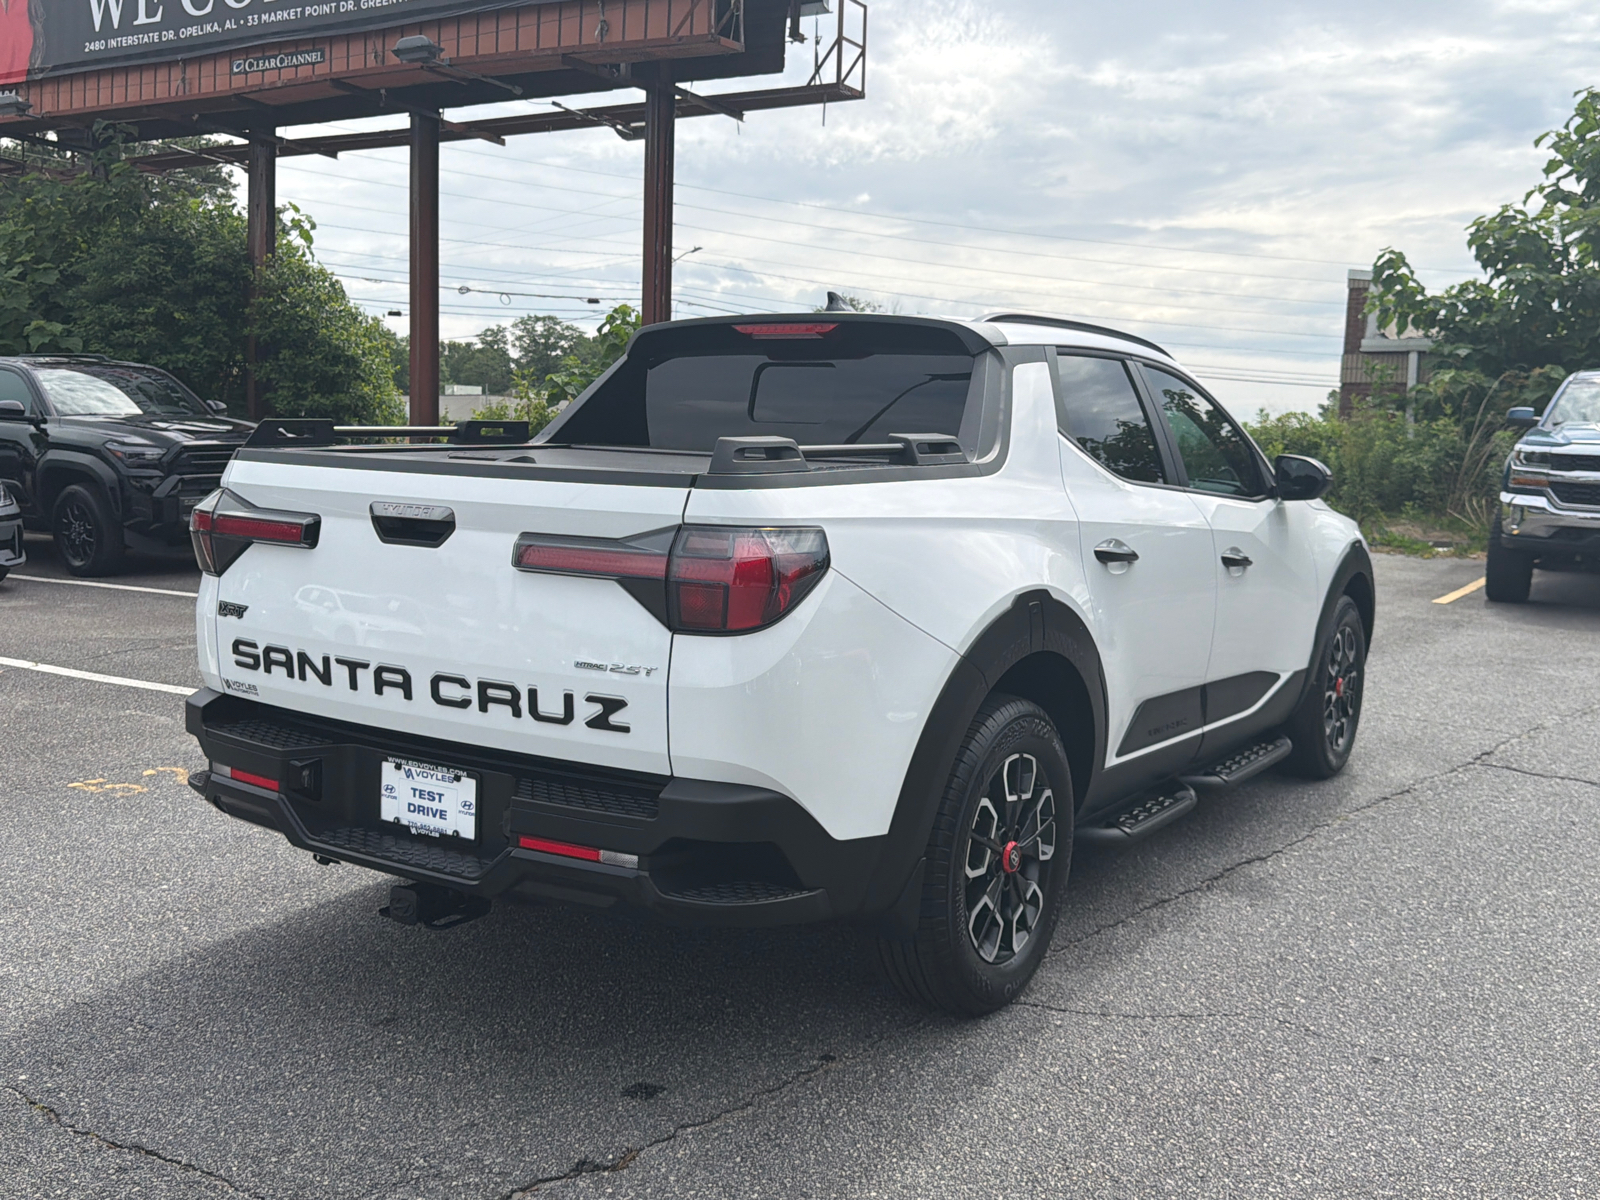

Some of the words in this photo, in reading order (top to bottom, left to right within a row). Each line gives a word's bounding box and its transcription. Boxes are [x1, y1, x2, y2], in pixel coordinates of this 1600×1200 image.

[84, 40, 106, 52] 2480
[107, 33, 159, 49] INTERSTATE
[161, 30, 177, 42] DR.
[179, 23, 222, 38] OPELIKA,
[224, 18, 237, 30] AL
[247, 15, 259, 26] 33
[261, 8, 301, 24] MARKET
[305, 3, 336, 18] POINT
[339, 1, 357, 12] DR.
[383, 504, 435, 517] HYUNDAI
[220, 602, 246, 616] XRT
[576, 661, 605, 671] HTRAC
[231, 680, 258, 691] VOYLES
[232, 638, 413, 700] SANTA
[429, 671, 632, 734] CRUZ
[387, 756, 467, 777] WWW.EDVOYLES.COM
[415, 769, 454, 784] VOYLES
[410, 787, 445, 803] TEST
[407, 802, 448, 821] DRIVE
[417, 828, 440, 838] VOYLES
